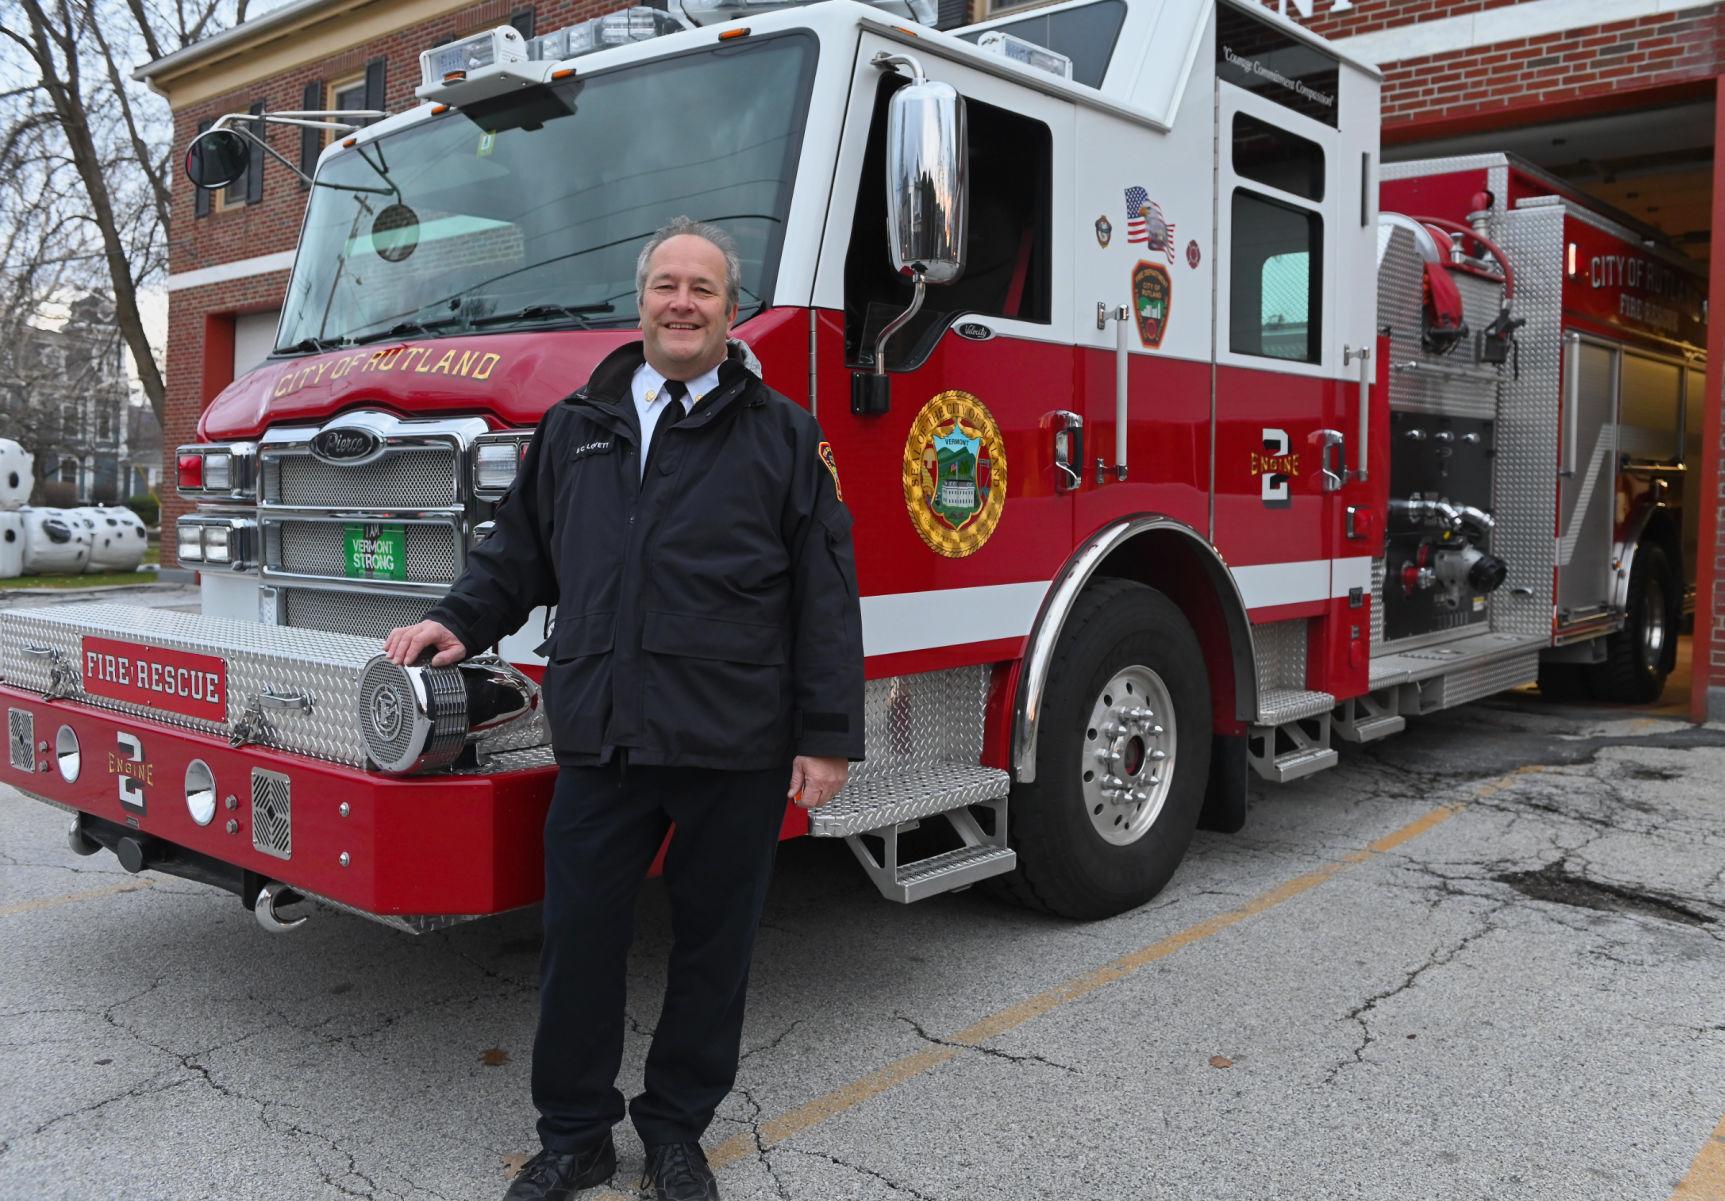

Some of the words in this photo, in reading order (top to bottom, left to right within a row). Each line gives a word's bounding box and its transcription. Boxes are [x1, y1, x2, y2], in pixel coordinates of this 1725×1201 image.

[1591, 256, 1625, 288] CITY
[1627, 257, 1643, 288] OF
[1620, 292, 1642, 321] FIRE
[964, 324, 988, 338] Velocity
[274, 361, 333, 398] CITY
[330, 352, 367, 380] OF
[362, 347, 501, 380] RUTLAND
[324, 431, 366, 456] Pierce
[910, 448, 922, 487] SEAL
[946, 401, 968, 416] CITY
[944, 438, 970, 447] VERMONT
[1250, 452, 1300, 476] ENGINE
[1262, 428, 1290, 501] 2
[352, 538, 394, 554] VERMONT
[353, 552, 395, 571] STRONG
[86, 651, 130, 685] FIRE
[136, 660, 219, 703] RESCUE
[108, 751, 154, 786] ENGINE
[116, 730, 144, 808] 2
